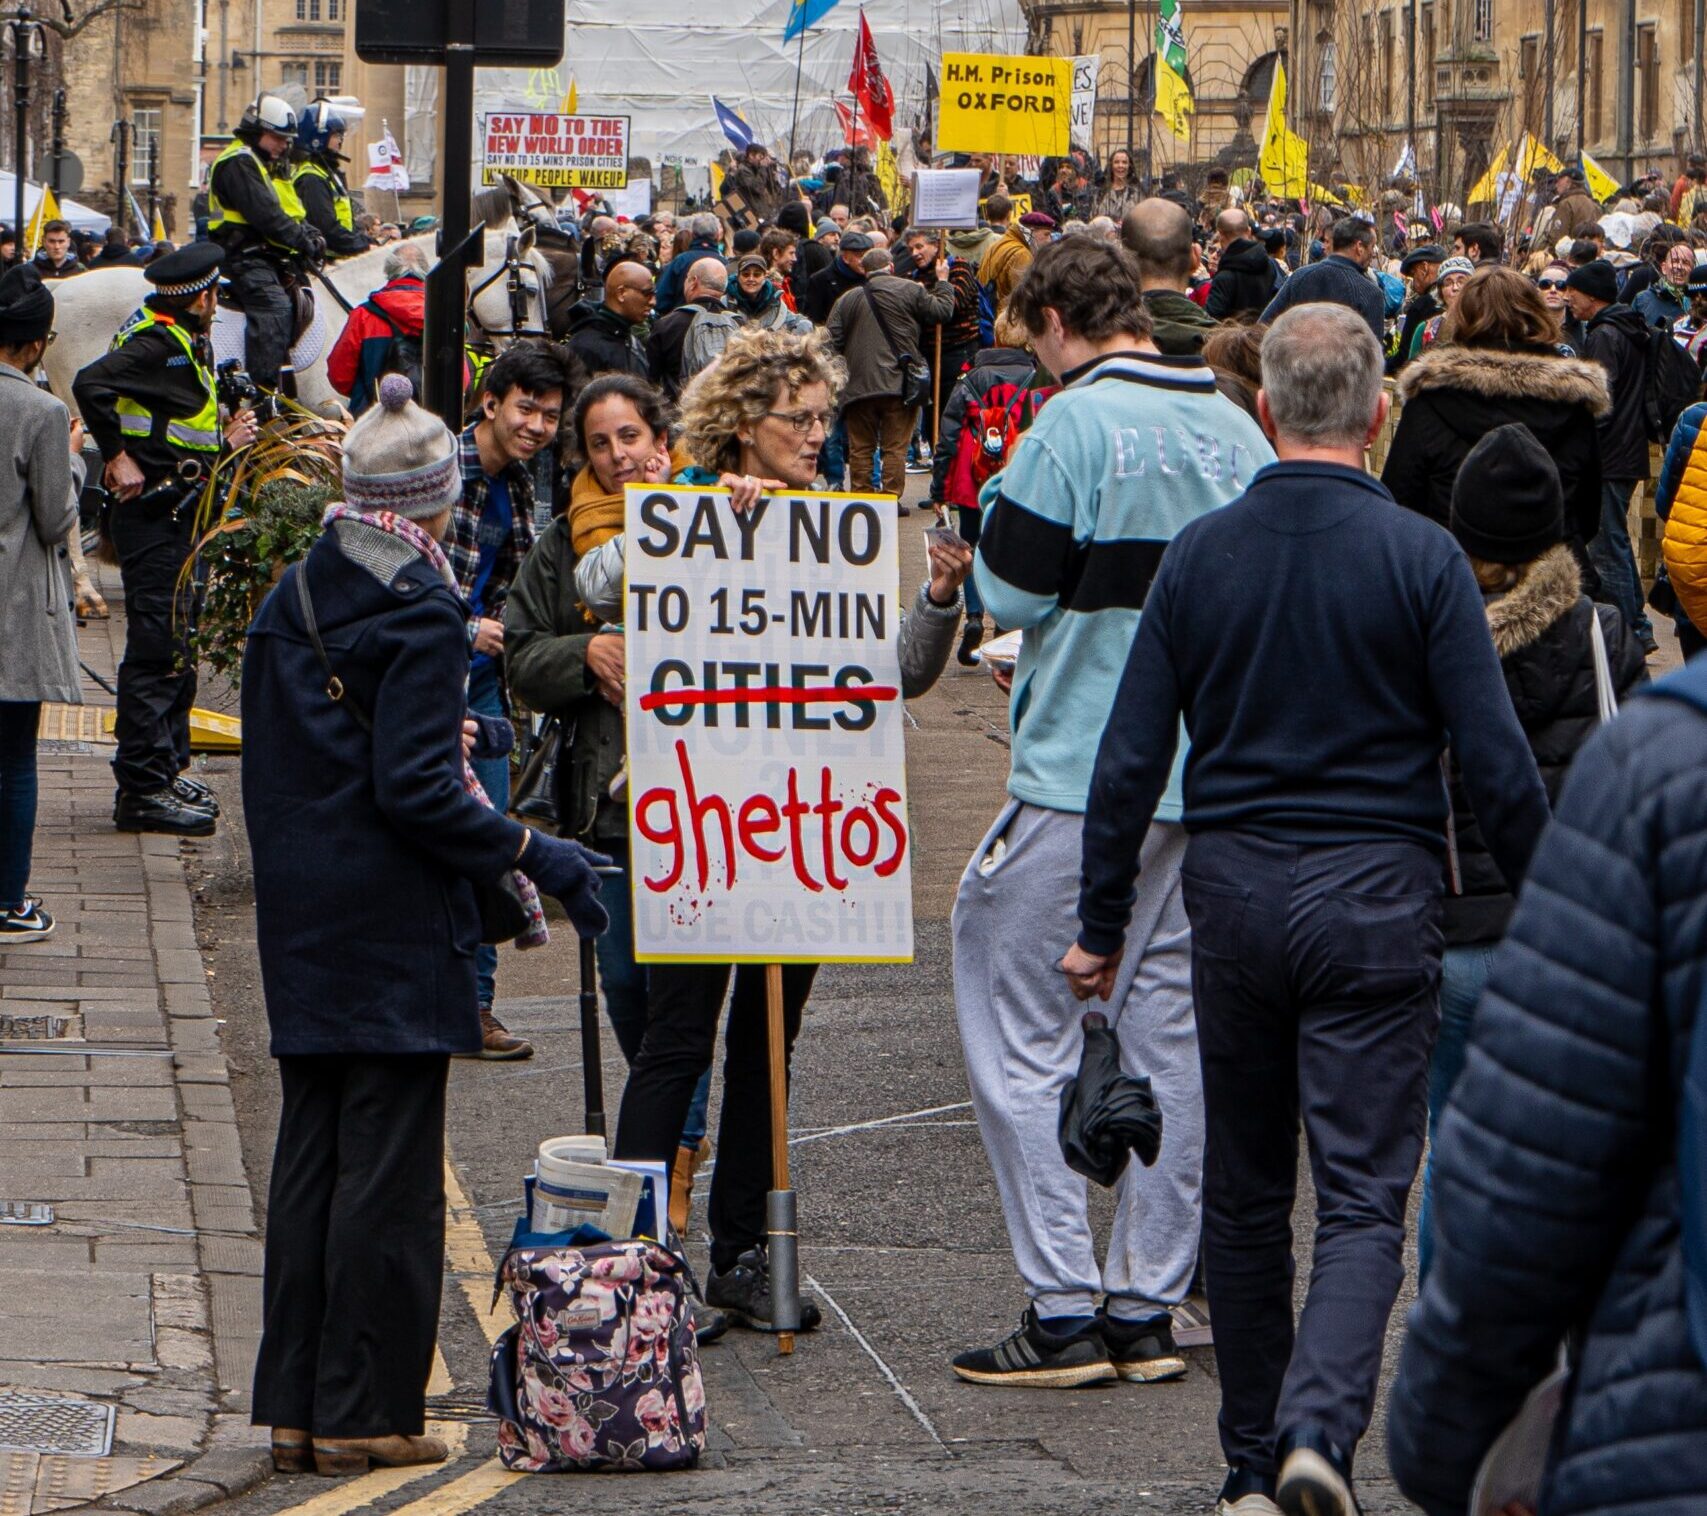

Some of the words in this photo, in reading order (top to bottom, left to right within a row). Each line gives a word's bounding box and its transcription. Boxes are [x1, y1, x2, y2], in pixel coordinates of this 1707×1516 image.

[947, 64, 983, 83] H.M.
[991, 66, 1055, 87] Prison
[1074, 65, 1092, 89] ES
[958, 92, 1055, 113] OXFORD
[491, 117, 525, 134] SAY
[529, 114, 558, 135] NO
[564, 119, 585, 135] TO
[590, 119, 623, 136] THE
[487, 135, 520, 153] NEW
[524, 136, 574, 155] WORLD
[578, 137, 623, 156] ORDER
[487, 155, 503, 165] SAY
[505, 155, 515, 165] NO
[518, 155, 528, 165] TO
[530, 155, 540, 166] 15
[543, 156, 564, 166] MINS
[566, 156, 595, 167] PRISON
[597, 157, 623, 167] CITIES
[486, 168, 529, 183] WEUP
[535, 169, 573, 185] PEOPLE
[579, 170, 623, 186] WAKEUP
[638, 492, 771, 561] SAY
[789, 500, 881, 566] NO
[630, 584, 690, 633] TO
[709, 587, 885, 640] 15-MIN
[649, 658, 877, 731] CITIES
[635, 739, 907, 893] ghettos
